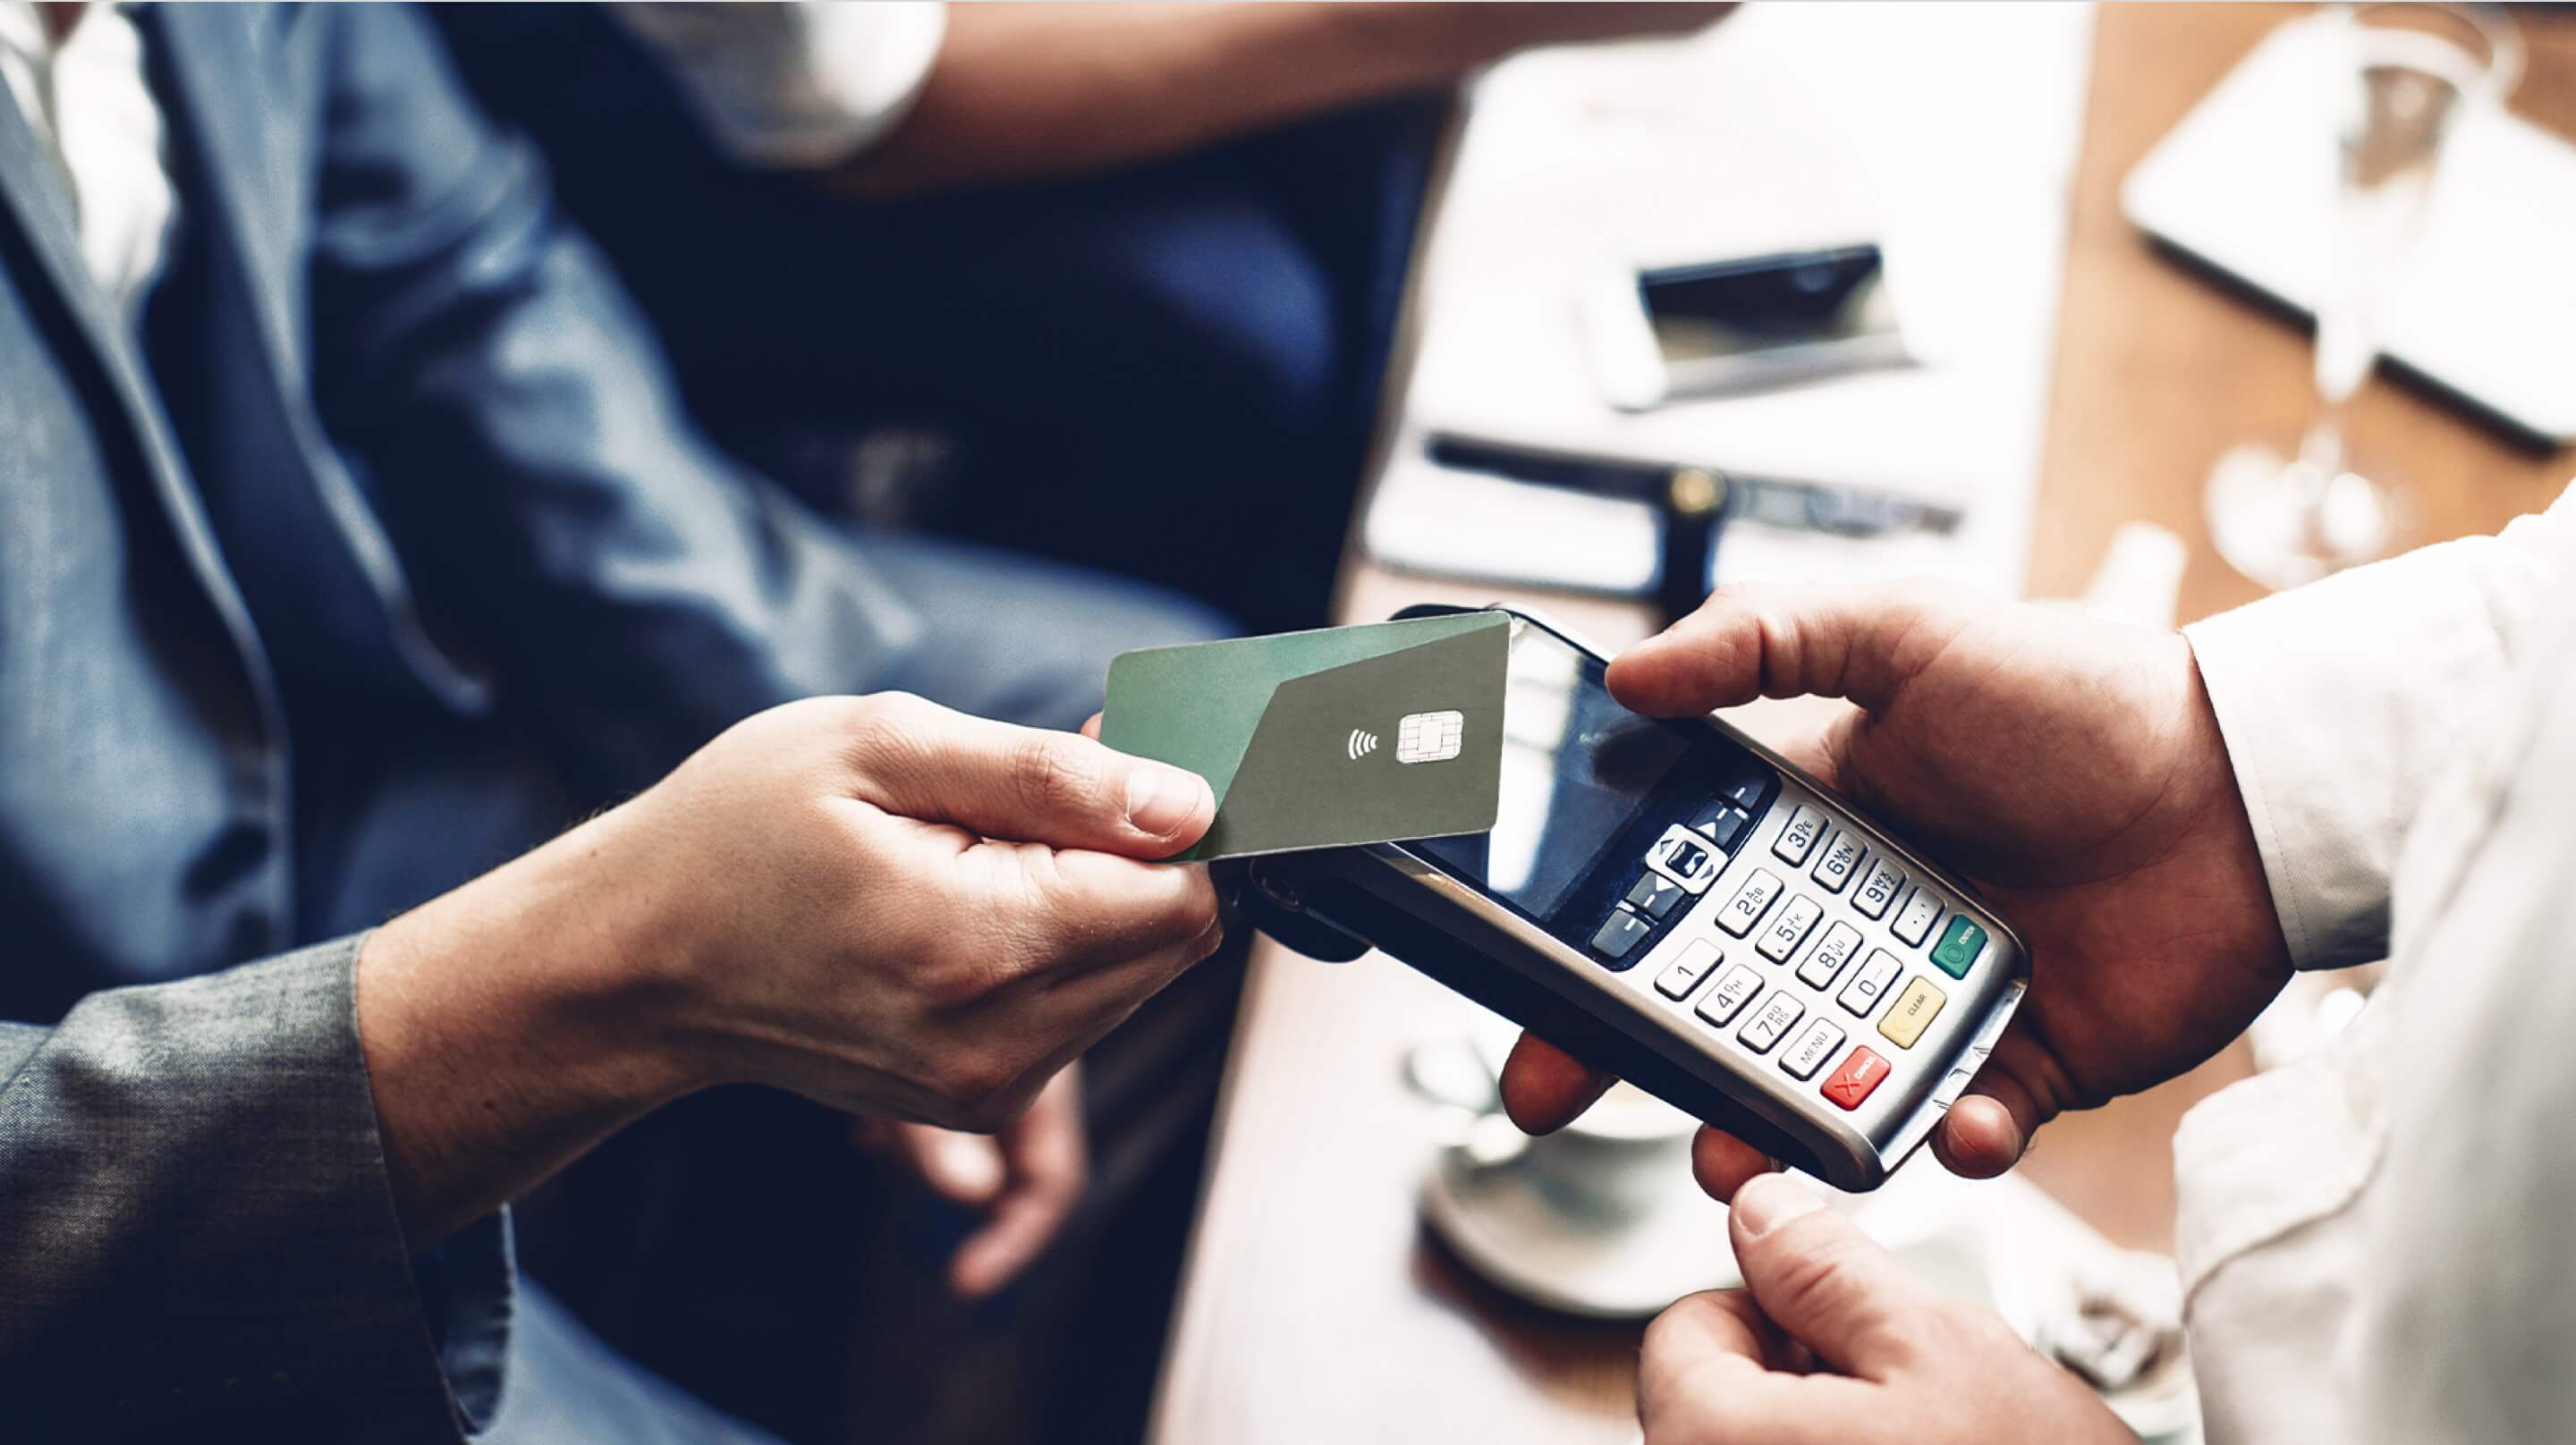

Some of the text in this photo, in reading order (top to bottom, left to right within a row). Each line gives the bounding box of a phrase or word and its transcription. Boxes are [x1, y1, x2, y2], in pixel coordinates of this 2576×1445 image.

[1788, 832, 1807, 849] 3
[1826, 859, 1845, 875] 6
[1866, 887, 1885, 903] 9
[1736, 900, 1756, 916] 2
[1776, 925, 1796, 942] 5
[1818, 952, 1836, 968] 8
[1677, 966, 1695, 976] 1
[1859, 979, 1877, 996] 0
[1716, 993, 1734, 1009] 4
[1907, 993, 1927, 1016] CLEAR
[1757, 1019, 1775, 1037] 7
[1800, 1031, 1828, 1064] MENU
